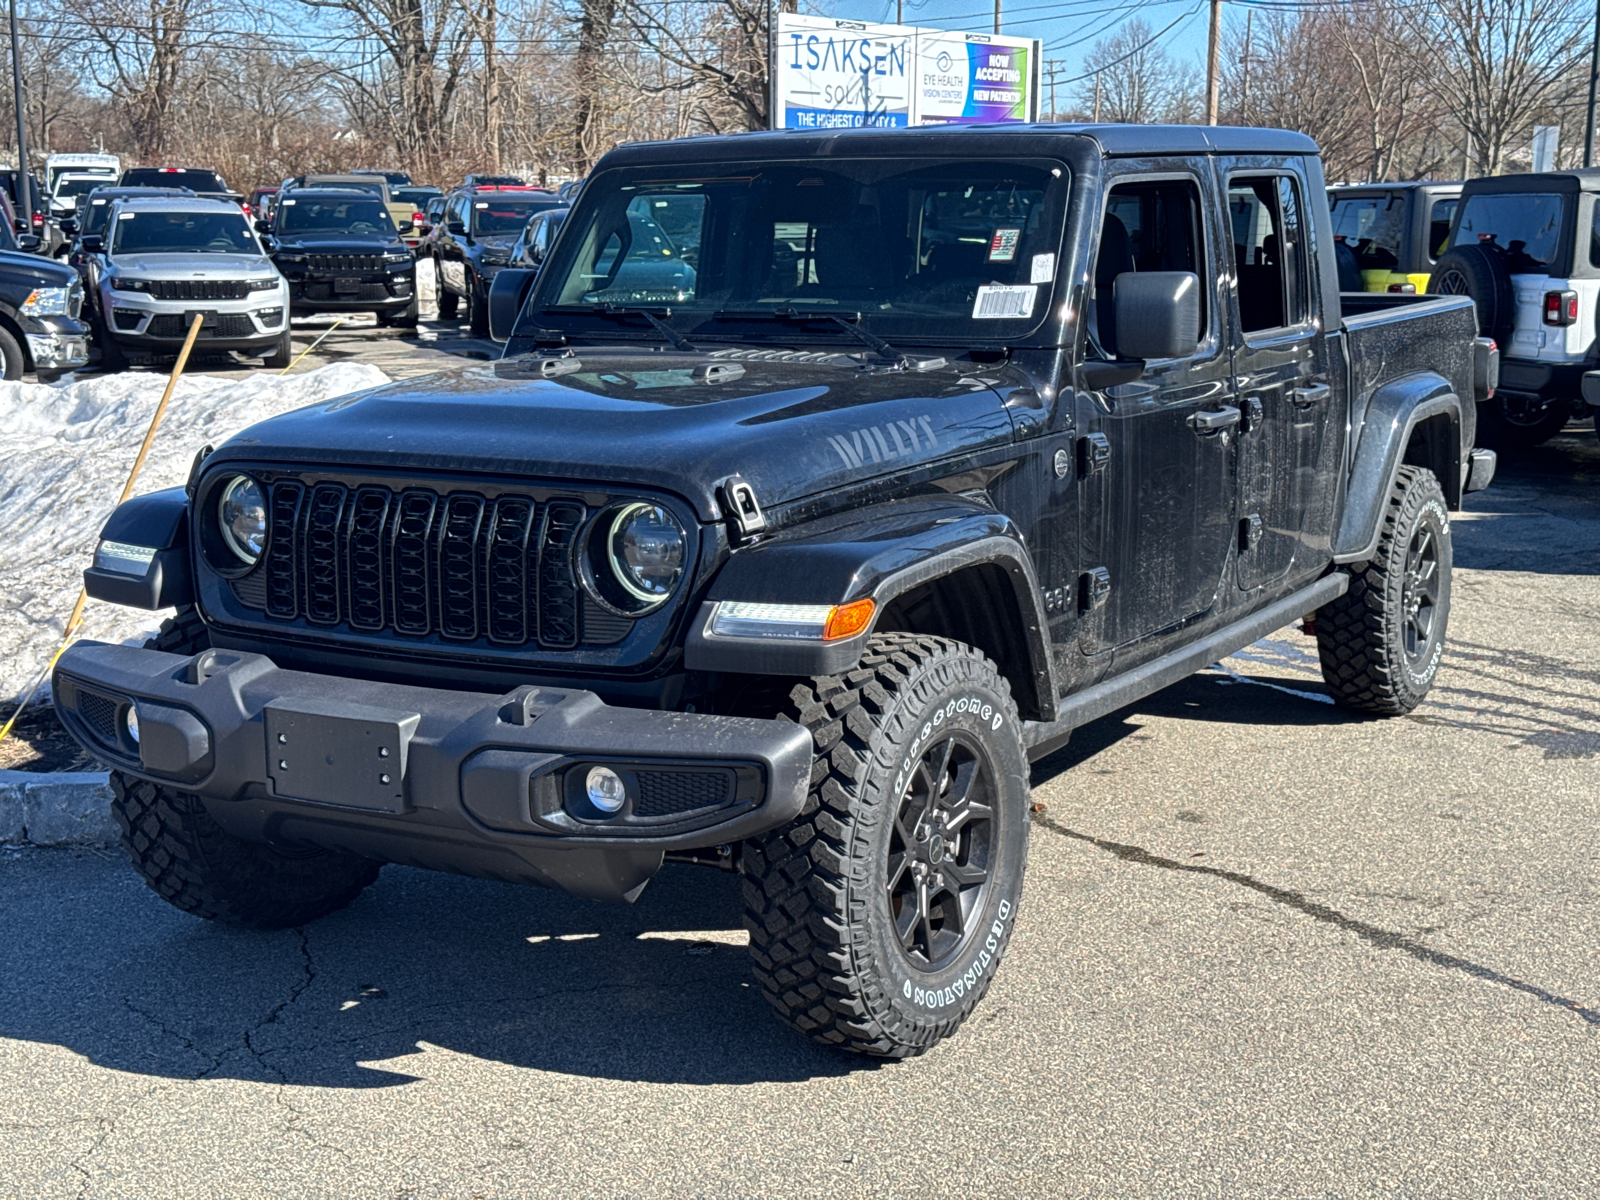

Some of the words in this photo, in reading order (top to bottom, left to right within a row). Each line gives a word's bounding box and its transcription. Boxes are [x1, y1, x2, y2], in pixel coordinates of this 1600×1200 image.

[790, 33, 905, 77] ISAKSEN
[988, 54, 1010, 68] NOW
[923, 74, 937, 87] EYE
[937, 75, 963, 87] HEALTH
[974, 66, 1021, 83] ACCEPTING
[922, 88, 940, 98] VISION
[941, 89, 963, 100] CENTERS
[972, 89, 990, 102] NEW
[796, 112, 816, 127] THE
[816, 112, 854, 128] HIGHEST
[827, 414, 939, 470] WILLYS
[894, 697, 992, 795] Firestone
[914, 898, 1011, 1009] DESTINATION
